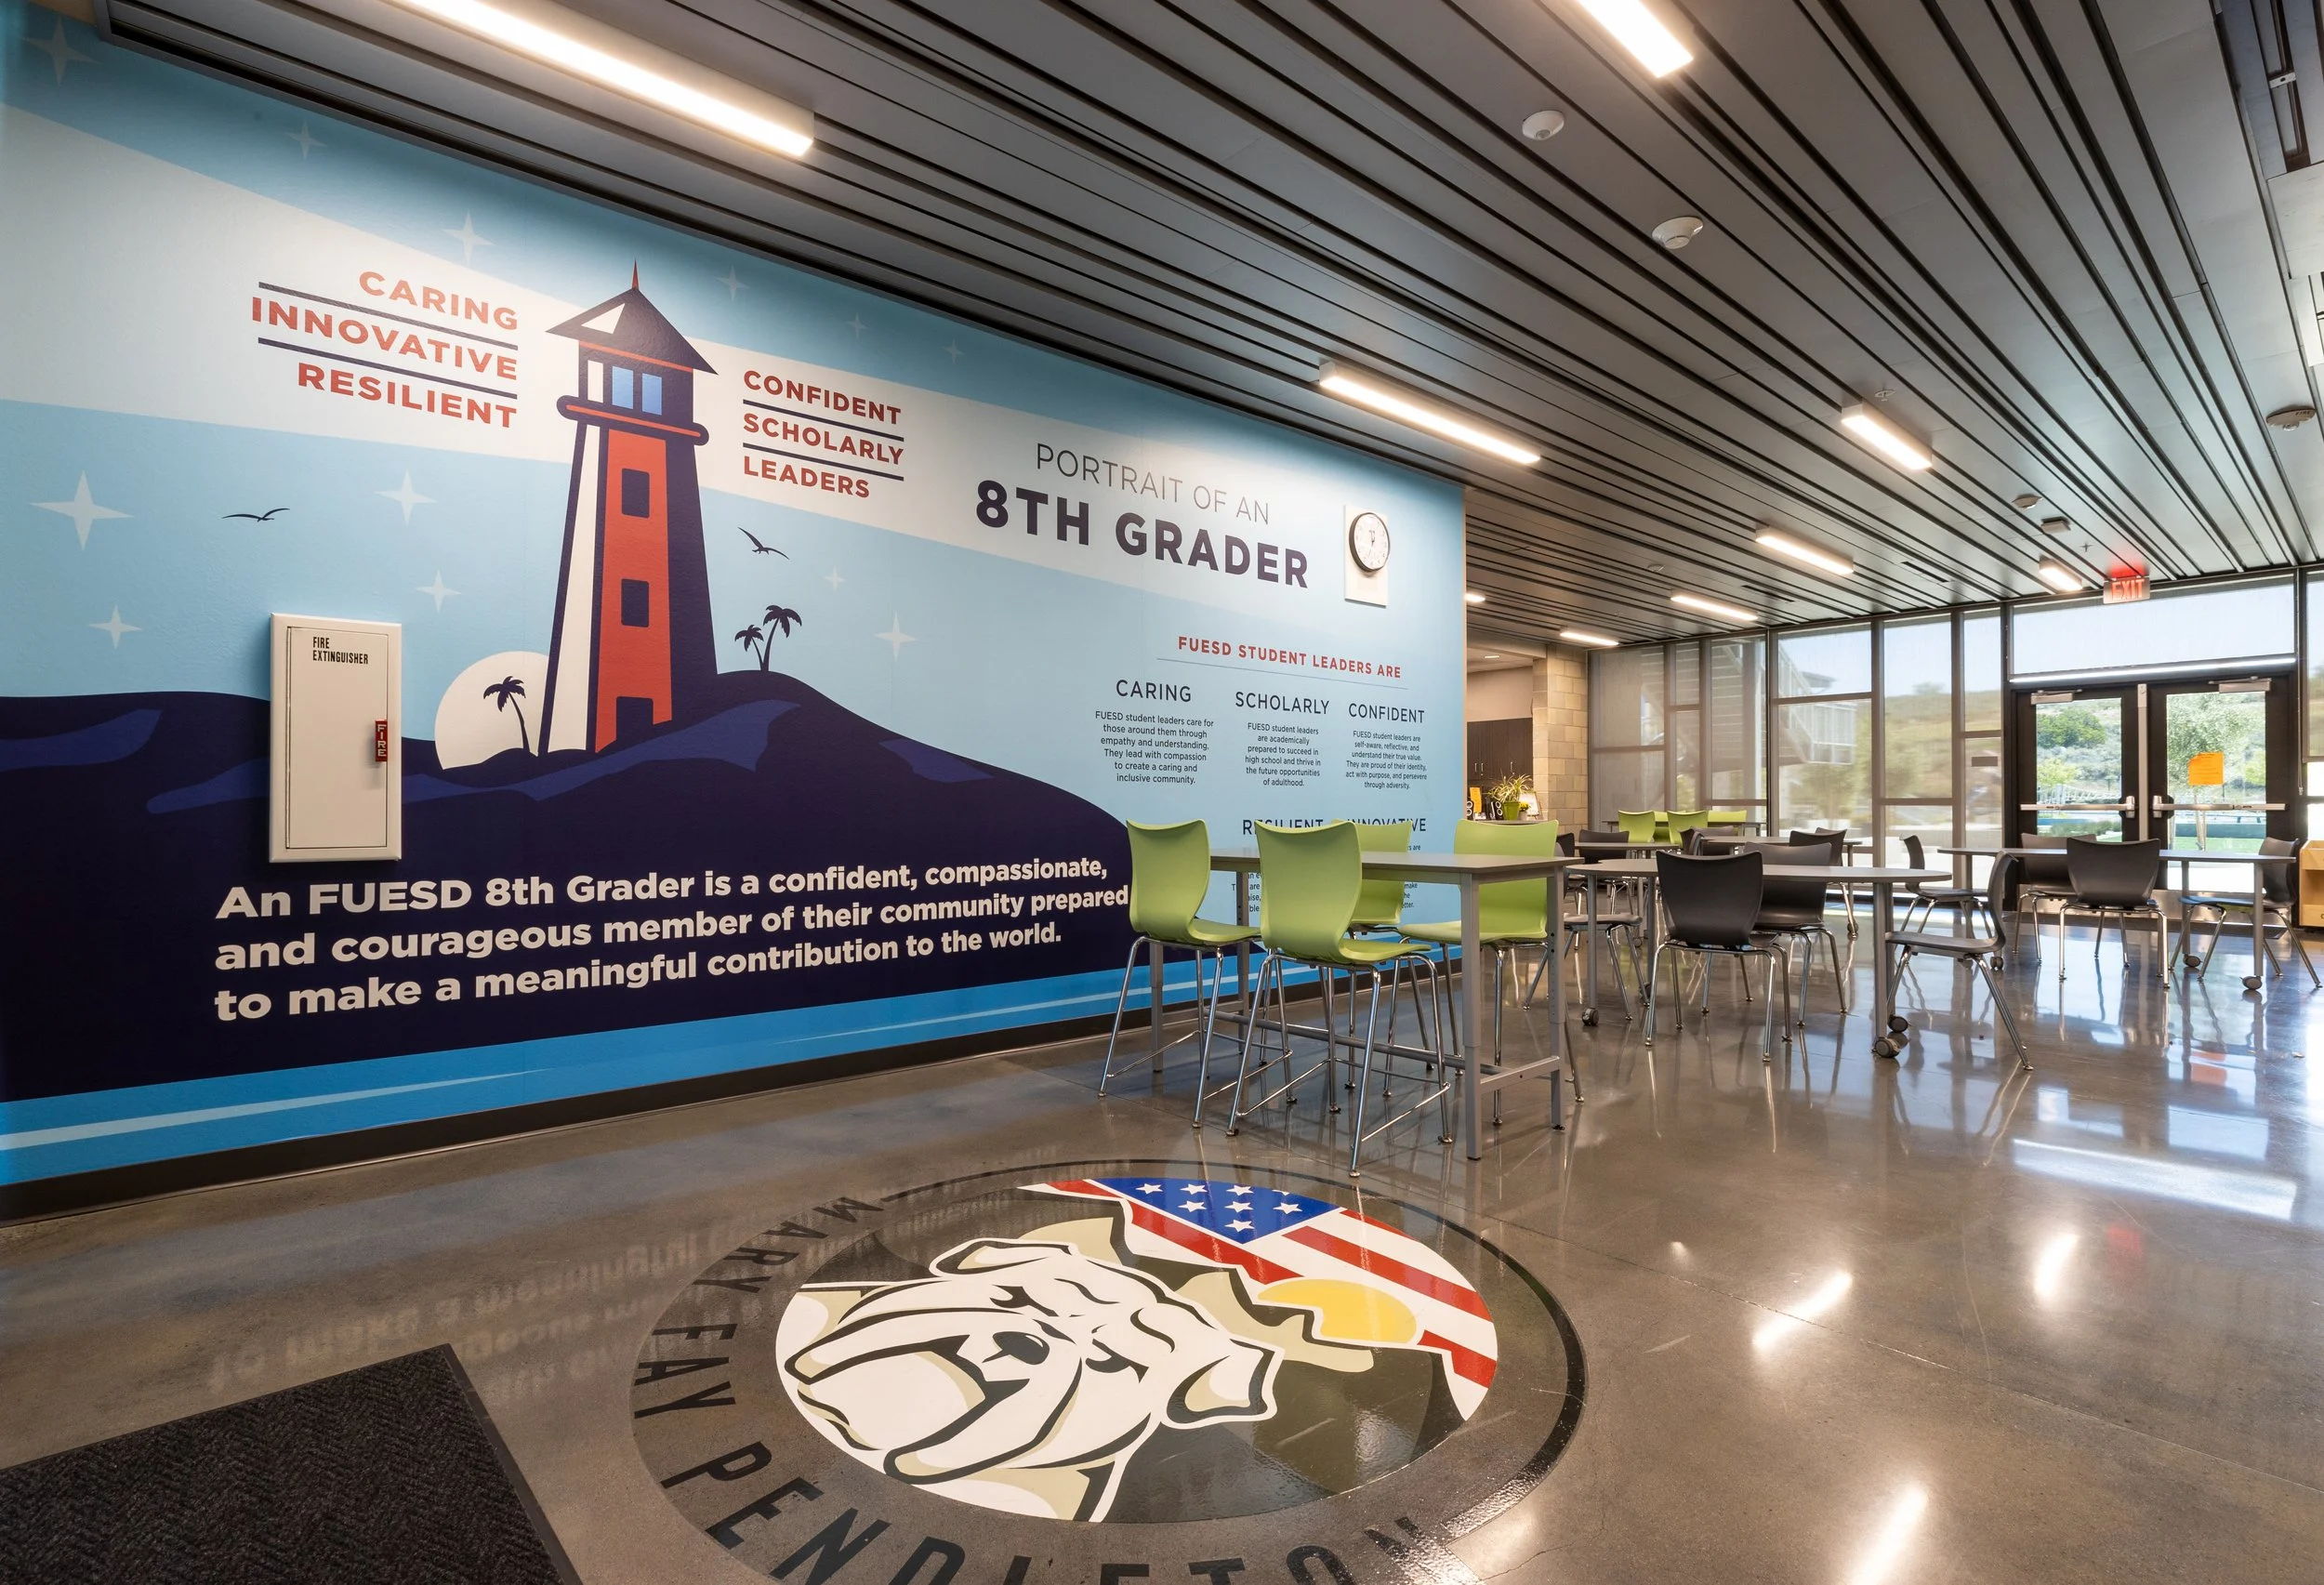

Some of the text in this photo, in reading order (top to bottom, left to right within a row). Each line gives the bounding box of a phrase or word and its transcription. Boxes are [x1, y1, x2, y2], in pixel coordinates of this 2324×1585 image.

[359, 271, 518, 330] CARING
[252, 297, 518, 381] INNOVATIVE
[297, 362, 518, 429] RESILIENT
[743, 369, 901, 426] CONFIDENT
[743, 413, 905, 466] SCHOLARLY
[743, 455, 870, 499] LEADERS
[1037, 442, 1269, 525] PORTRAIT OF AN
[975, 480, 1089, 547] 8TH
[1115, 511, 1309, 589] GRADER
[2111, 578, 2146, 601] EXIT
[312, 636, 330, 650] FIRE
[312, 650, 369, 666] EXTINGUISHER
[1178, 636, 1402, 679] FUESD STUDENT LEADERS ARE
[1116, 679, 1192, 703] CARING
[1235, 691, 1330, 715] SCHOLARLY
[1095, 710, 1124, 720] FUESD
[1125, 713, 1155, 723] student
[1157, 715, 1184, 725] leaders
[1204, 719, 1214, 727] for
[1348, 702, 1425, 724] CONFIDENT
[1103, 723, 1208, 740] those around them through
[1248, 722, 1319, 734] FUESD student leaders
[1353, 730, 1371, 738] FUESD
[1372, 732, 1393, 740] student
[1393, 733, 1412, 742] leaders
[377, 724, 387, 757] FIRE
[1101, 737, 1209, 752] empathy and understanding.
[1269, 735, 1310, 746] academically
[1354, 741, 1383, 749] self-aware,
[1383, 743, 1408, 751] reflective,
[1103, 748, 1207, 761] They lead with compassion
[1248, 746, 1277, 754] prepared
[1351, 751, 1382, 759] understand
[1114, 761, 1123, 770] to
[1125, 762, 1150, 771] create
[1158, 763, 1182, 773] caring
[1183, 764, 1197, 773] and
[1245, 755, 1260, 764] high
[1261, 756, 1282, 764] school
[1296, 758, 1314, 766] thrive
[1346, 759, 1360, 769] They
[1406, 763, 1427, 772] identity,
[1116, 773, 1195, 785] inclusive community.
[1246, 766, 1257, 774] the
[1258, 766, 1278, 775] future
[1368, 772, 1392, 780] purpose,
[1271, 778, 1304, 786] adulthood.
[1364, 781, 1410, 790] through adversity.
[1243, 819, 1324, 835] RIIENT
[215, 857, 1107, 919] An FUESD 8th Grader is a confident, compassionate,
[215, 885, 1129, 971] and courageous member of their community prepared
[215, 921, 1062, 1022] to make a meaningful contribution to the world.
[691, 1196, 885, 1294] MARY
[634, 1323, 738, 1420] FAY
